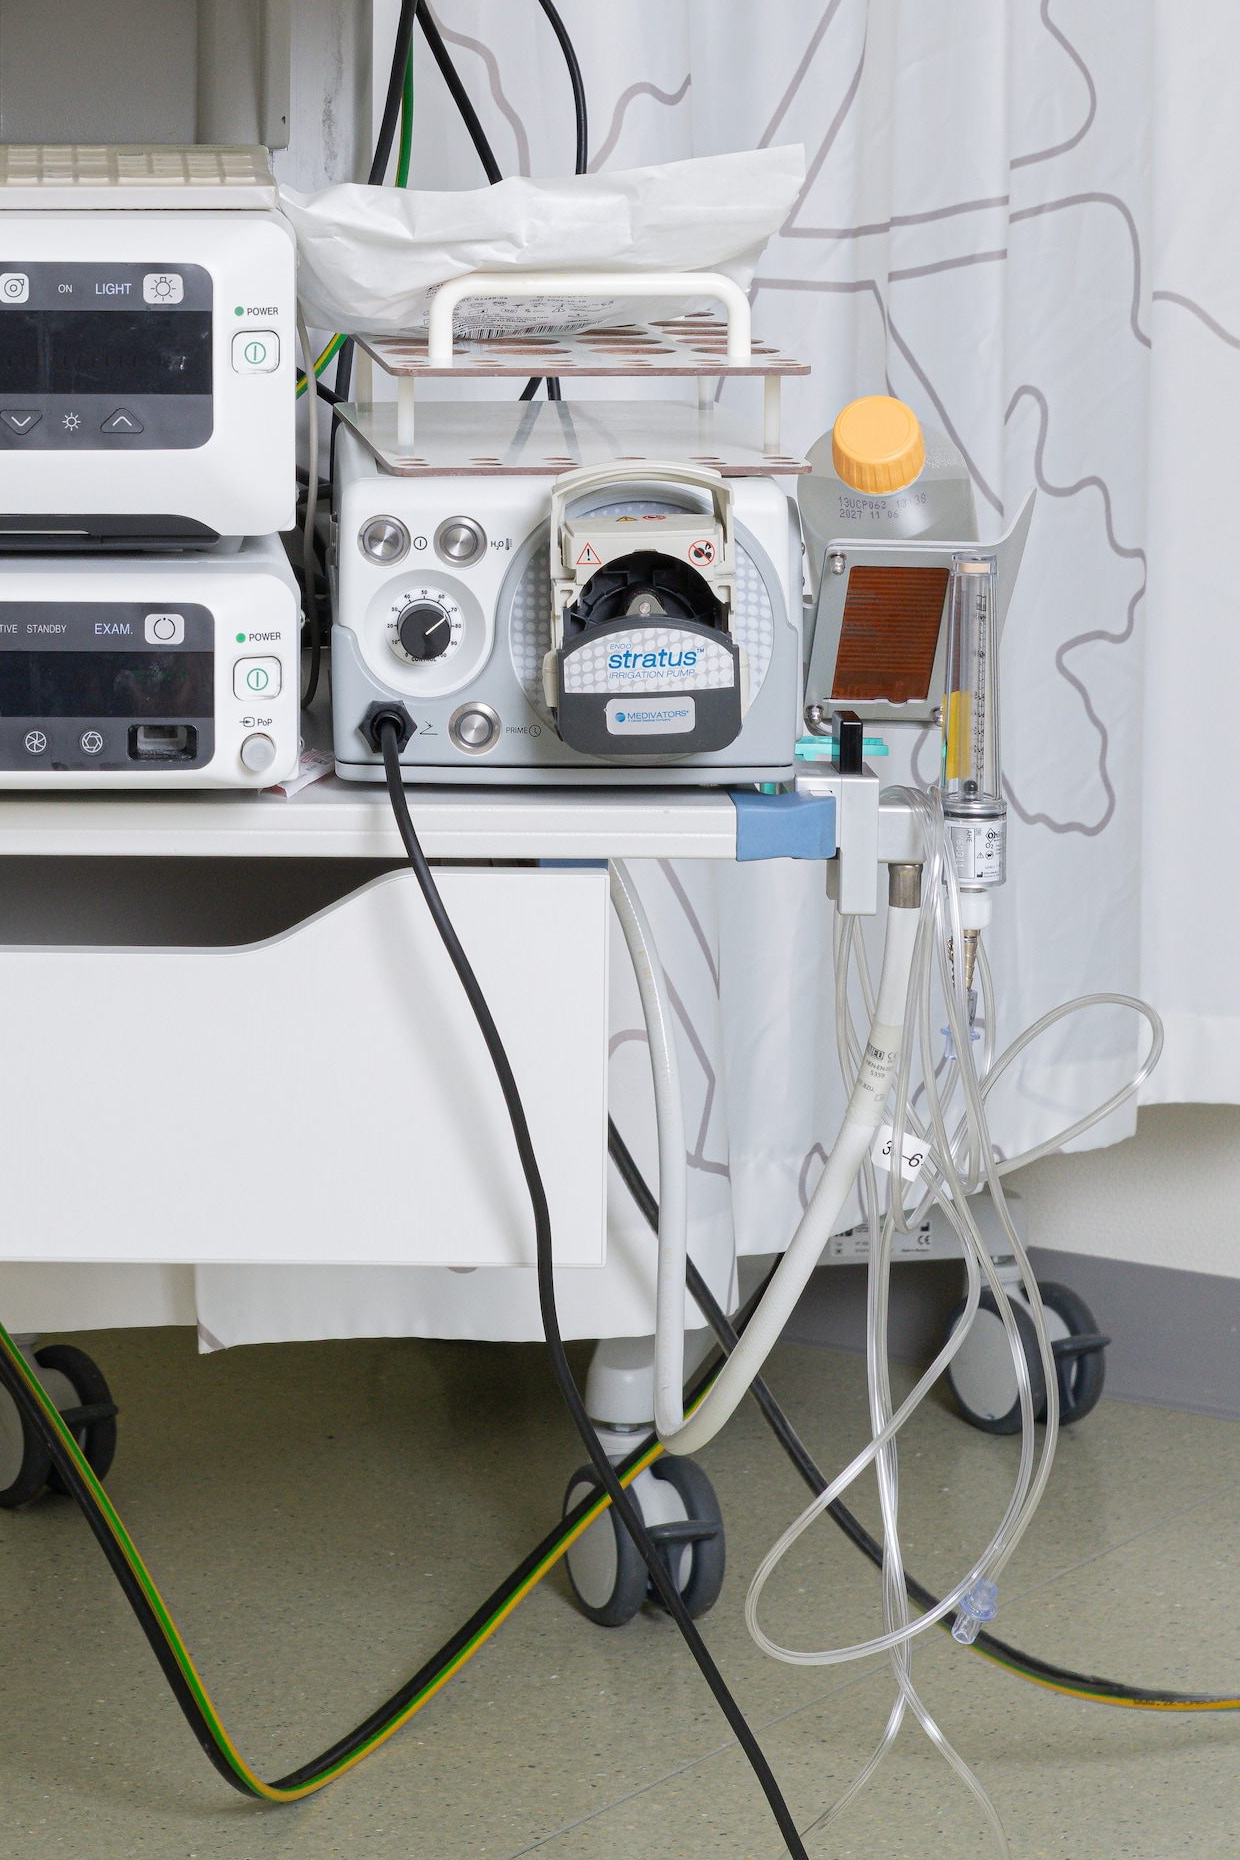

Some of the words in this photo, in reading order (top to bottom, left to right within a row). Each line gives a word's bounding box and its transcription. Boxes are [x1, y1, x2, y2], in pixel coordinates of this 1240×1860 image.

[58, 284, 73, 293] ON
[95, 283, 132, 295] LIGHT
[246, 306, 279, 316] POWER
[839, 508, 862, 519] 2027
[870, 511, 880, 519] 11
[26, 624, 67, 634] STANDBY
[94, 623, 133, 635] EXAM.
[248, 631, 281, 642] POWER
[609, 670, 667, 680] IRRIGATION
[666, 669, 695, 678] PUMP
[257, 718, 273, 726] PoP
[505, 725, 529, 735] PRIME
